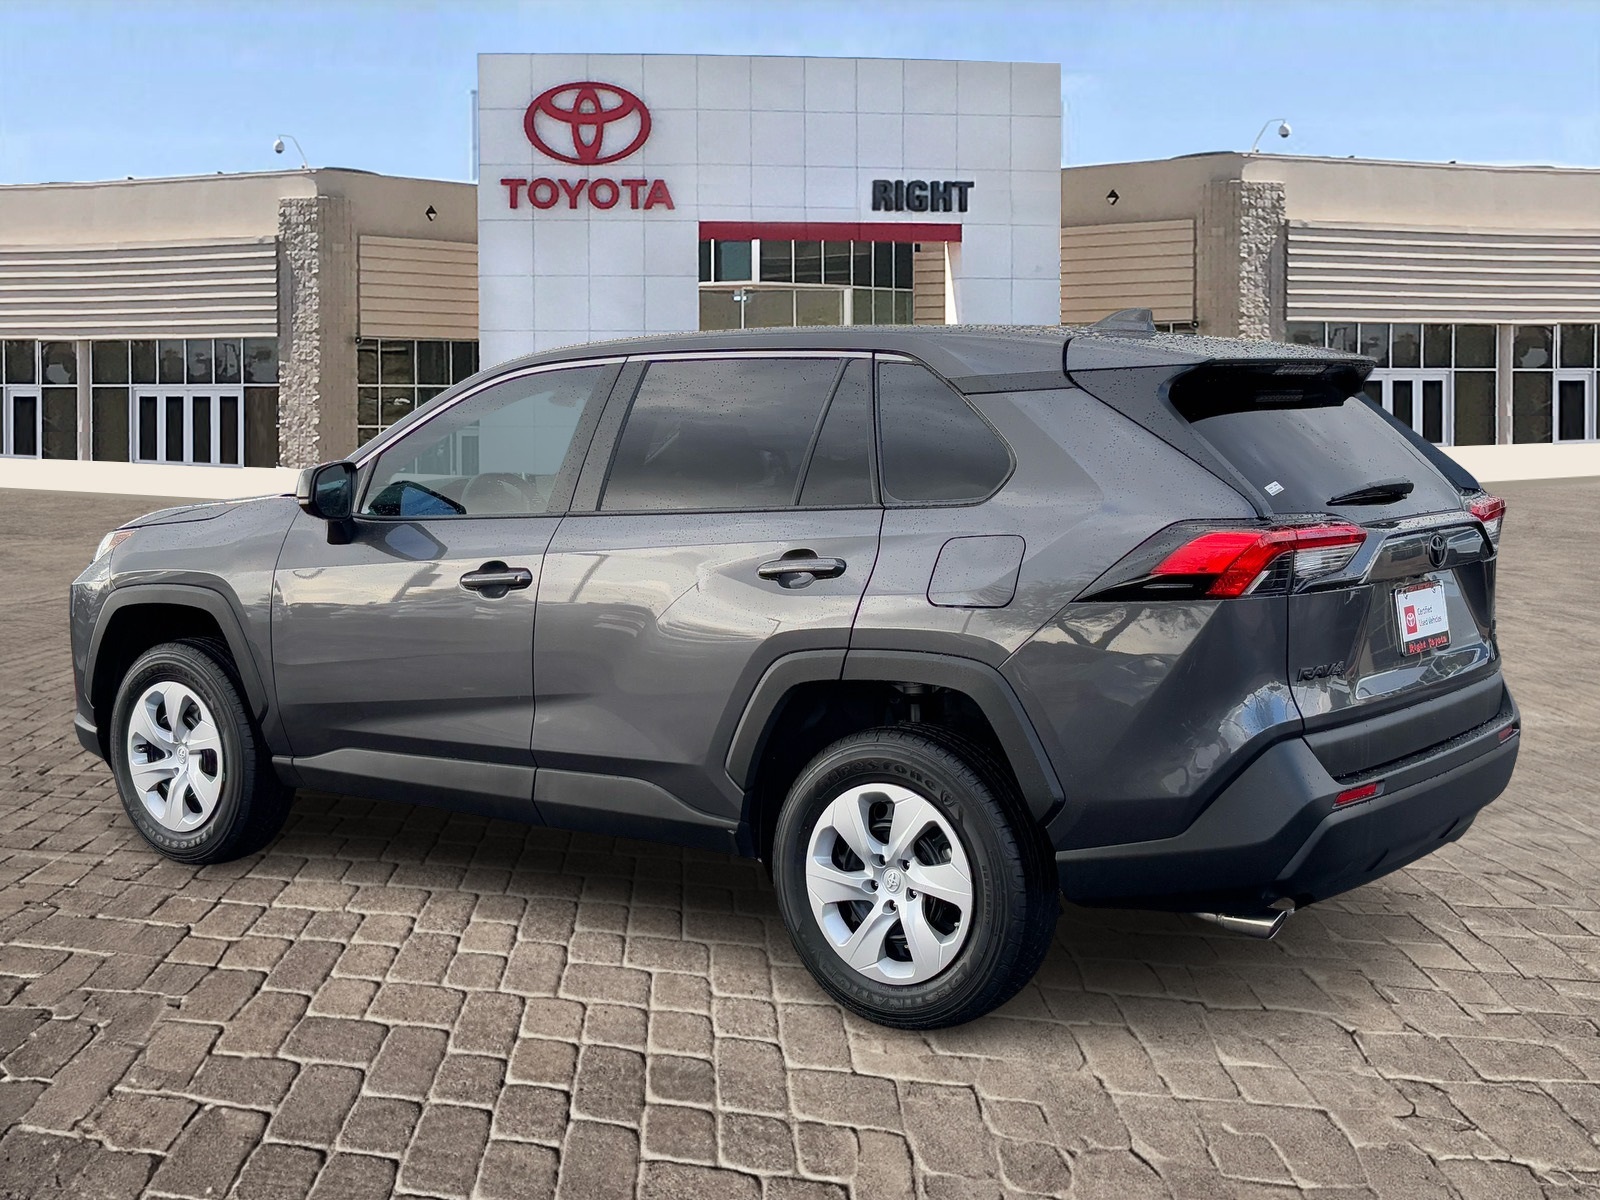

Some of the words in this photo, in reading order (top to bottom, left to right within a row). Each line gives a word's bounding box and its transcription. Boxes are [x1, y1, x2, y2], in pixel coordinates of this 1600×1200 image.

[500, 178, 675, 210] TOYOTA
[871, 179, 974, 213] RIGHT
[1408, 640, 1427, 653] Right
[1429, 635, 1447, 648] Toyota
[1297, 660, 1345, 682] RAV4
